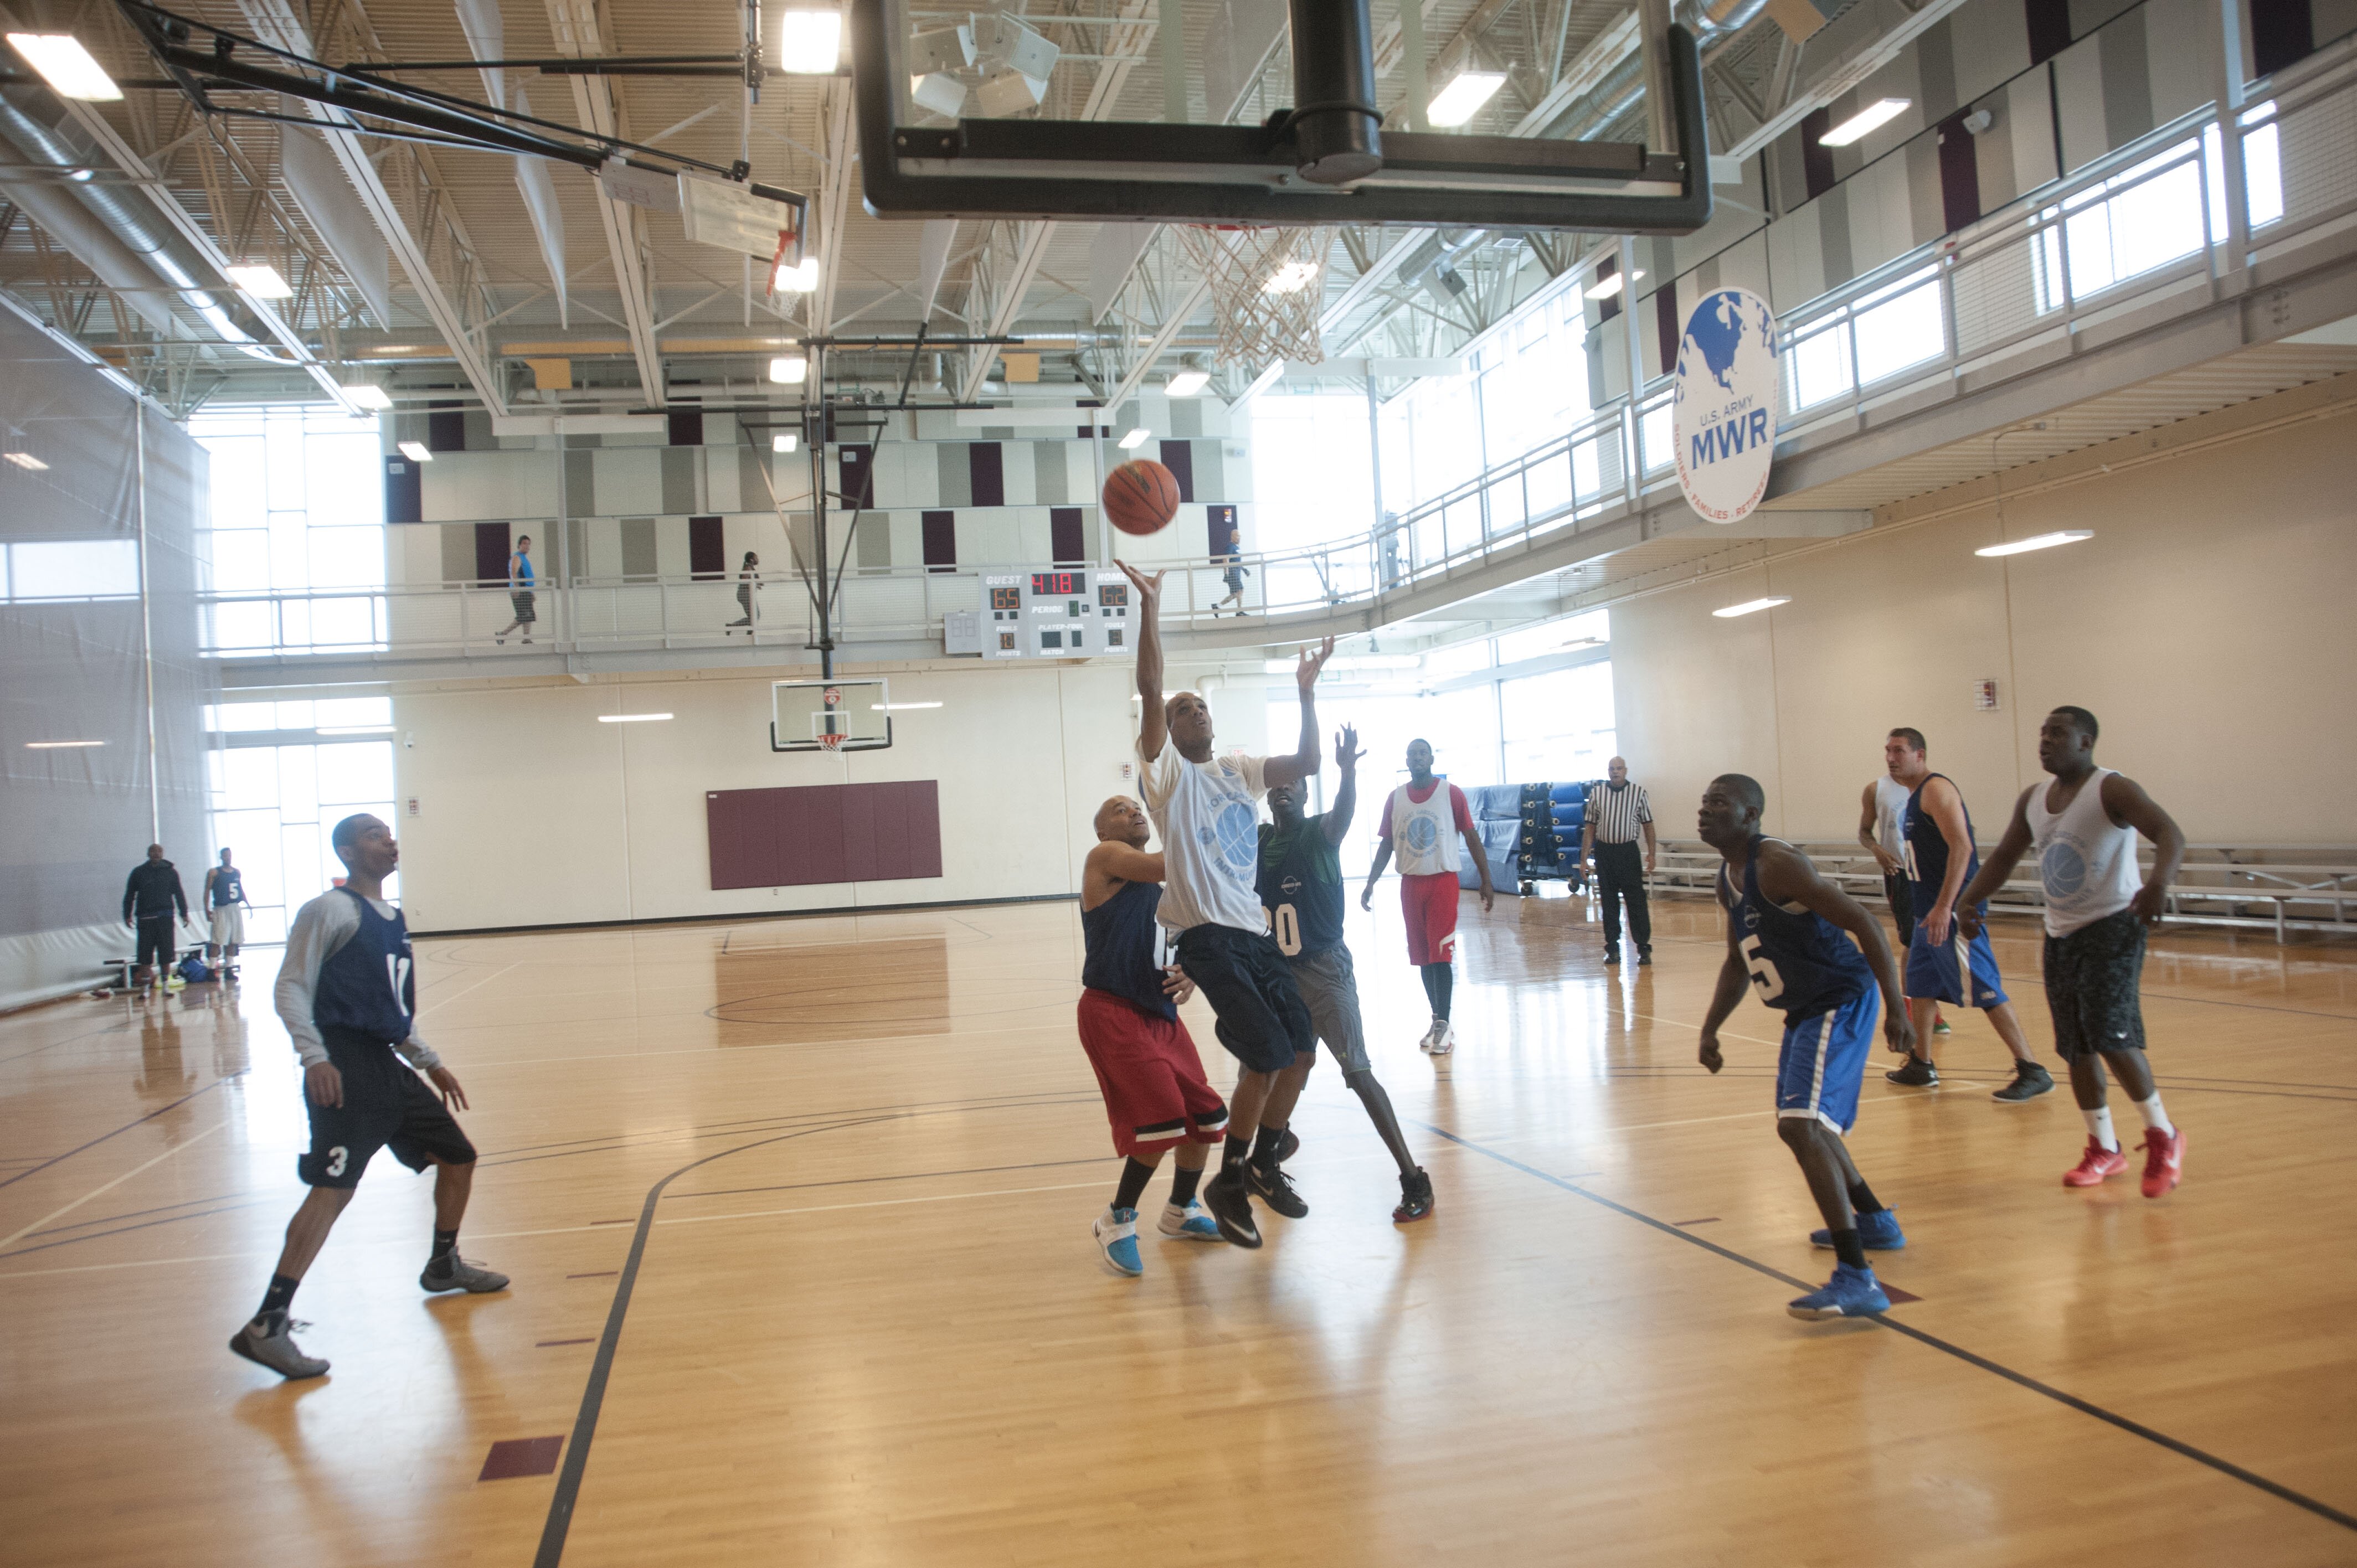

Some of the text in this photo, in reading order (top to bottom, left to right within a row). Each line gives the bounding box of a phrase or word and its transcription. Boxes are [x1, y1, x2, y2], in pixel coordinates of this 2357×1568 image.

[1700, 394, 1754, 426] U.S. ARMY
[1691, 407, 1767, 470] MWR
[1691, 494, 1728, 519] FAMILIES
[986, 575, 1022, 585] GUEST
[1097, 572, 1128, 581] HOME
[994, 589, 1018, 608] 65
[1102, 586, 1126, 605] 62
[229, 883, 238, 899] 5
[1739, 934, 1784, 1002] 5
[326, 1146, 348, 1177] 3
